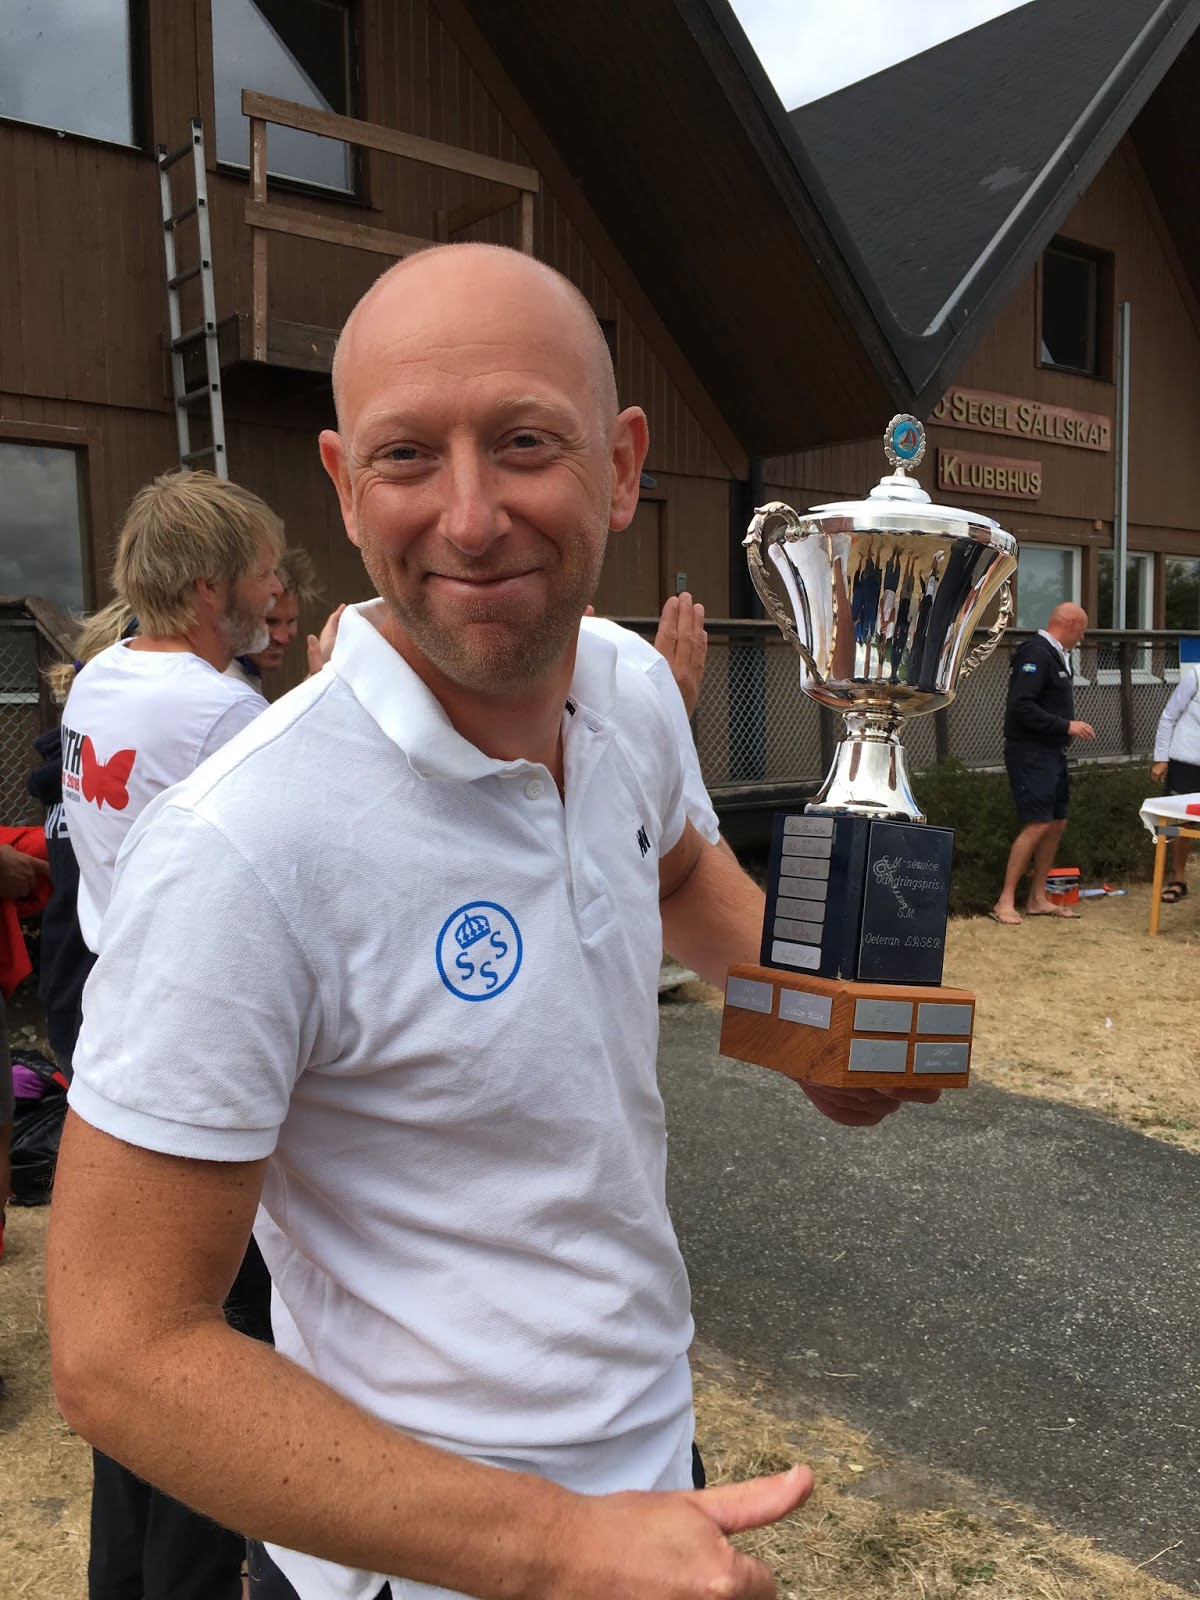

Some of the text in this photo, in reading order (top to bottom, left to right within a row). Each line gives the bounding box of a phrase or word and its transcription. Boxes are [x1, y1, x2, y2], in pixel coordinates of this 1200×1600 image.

[951, 391, 1013, 431] SEGEL
[1017, 404, 1111, 446] SÄLLSKAP
[942, 455, 1042, 495] KLUBBHUS
